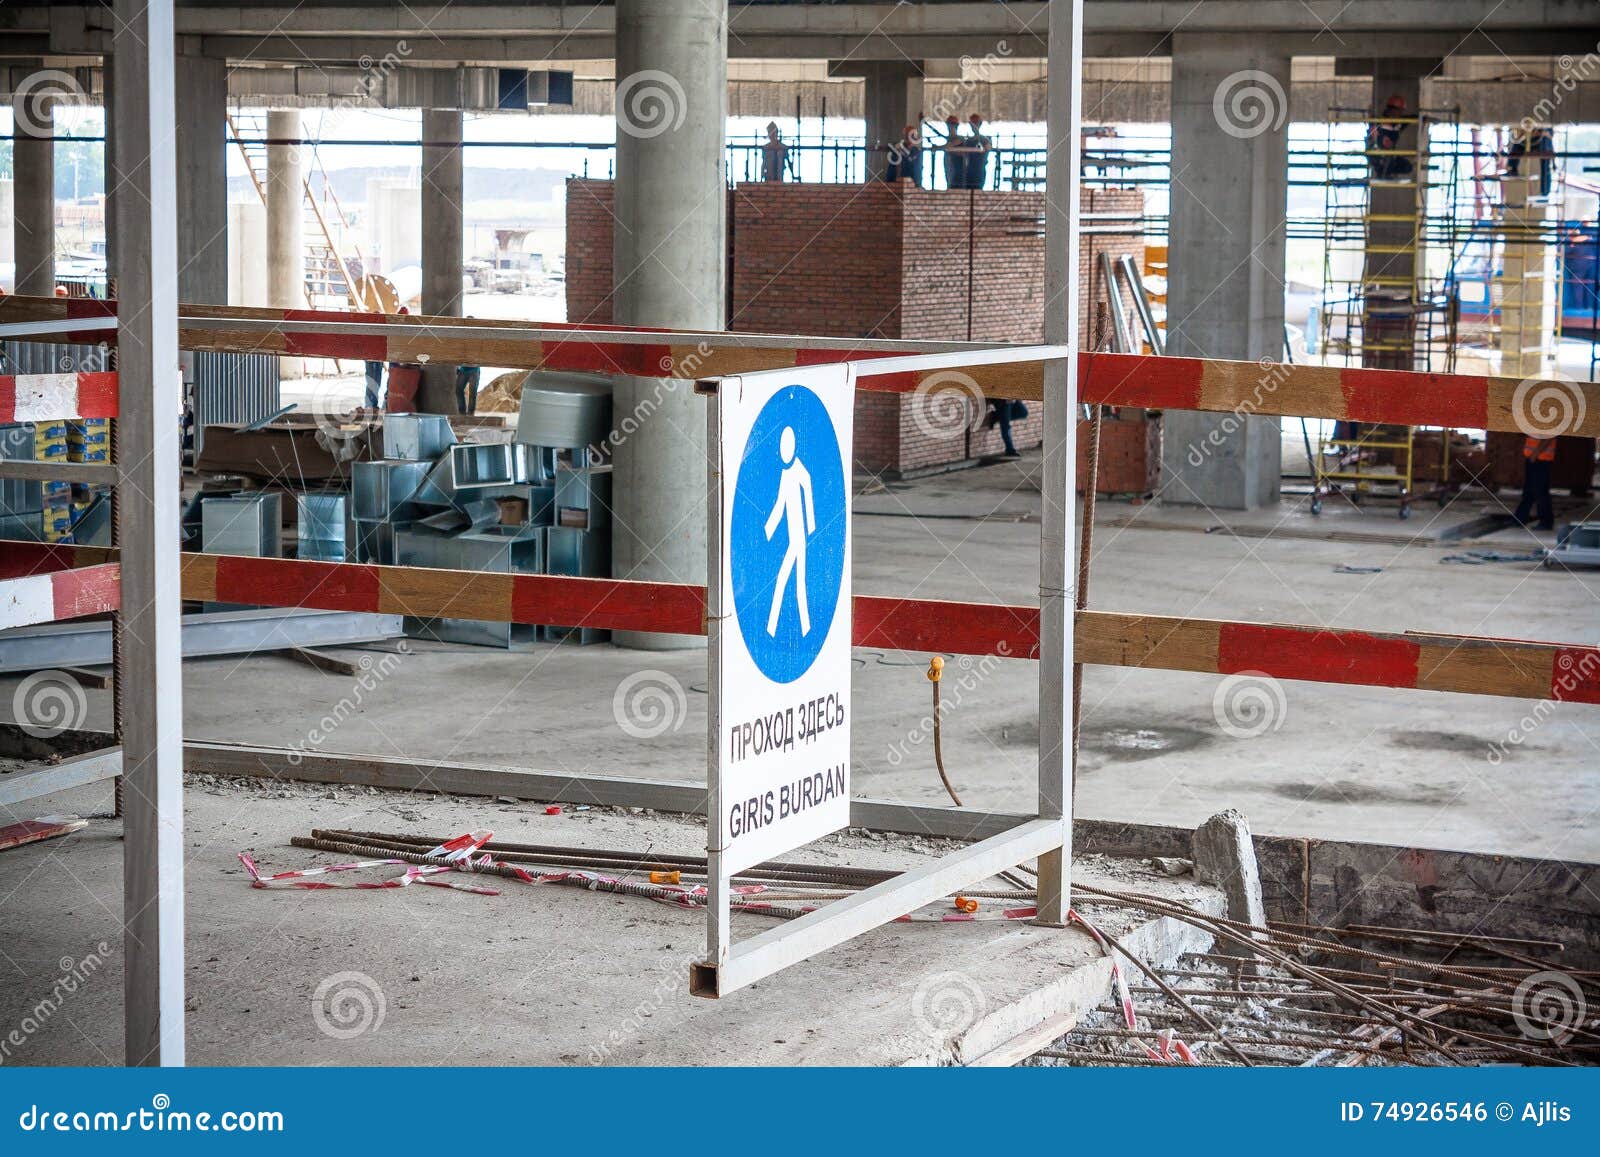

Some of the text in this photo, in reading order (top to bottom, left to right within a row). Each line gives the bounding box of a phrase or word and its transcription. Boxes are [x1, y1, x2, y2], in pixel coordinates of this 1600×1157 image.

[731, 692, 844, 764] ПРОХОД ЗДЕСЬ
[729, 763, 845, 839] GIRIS BURDAN
